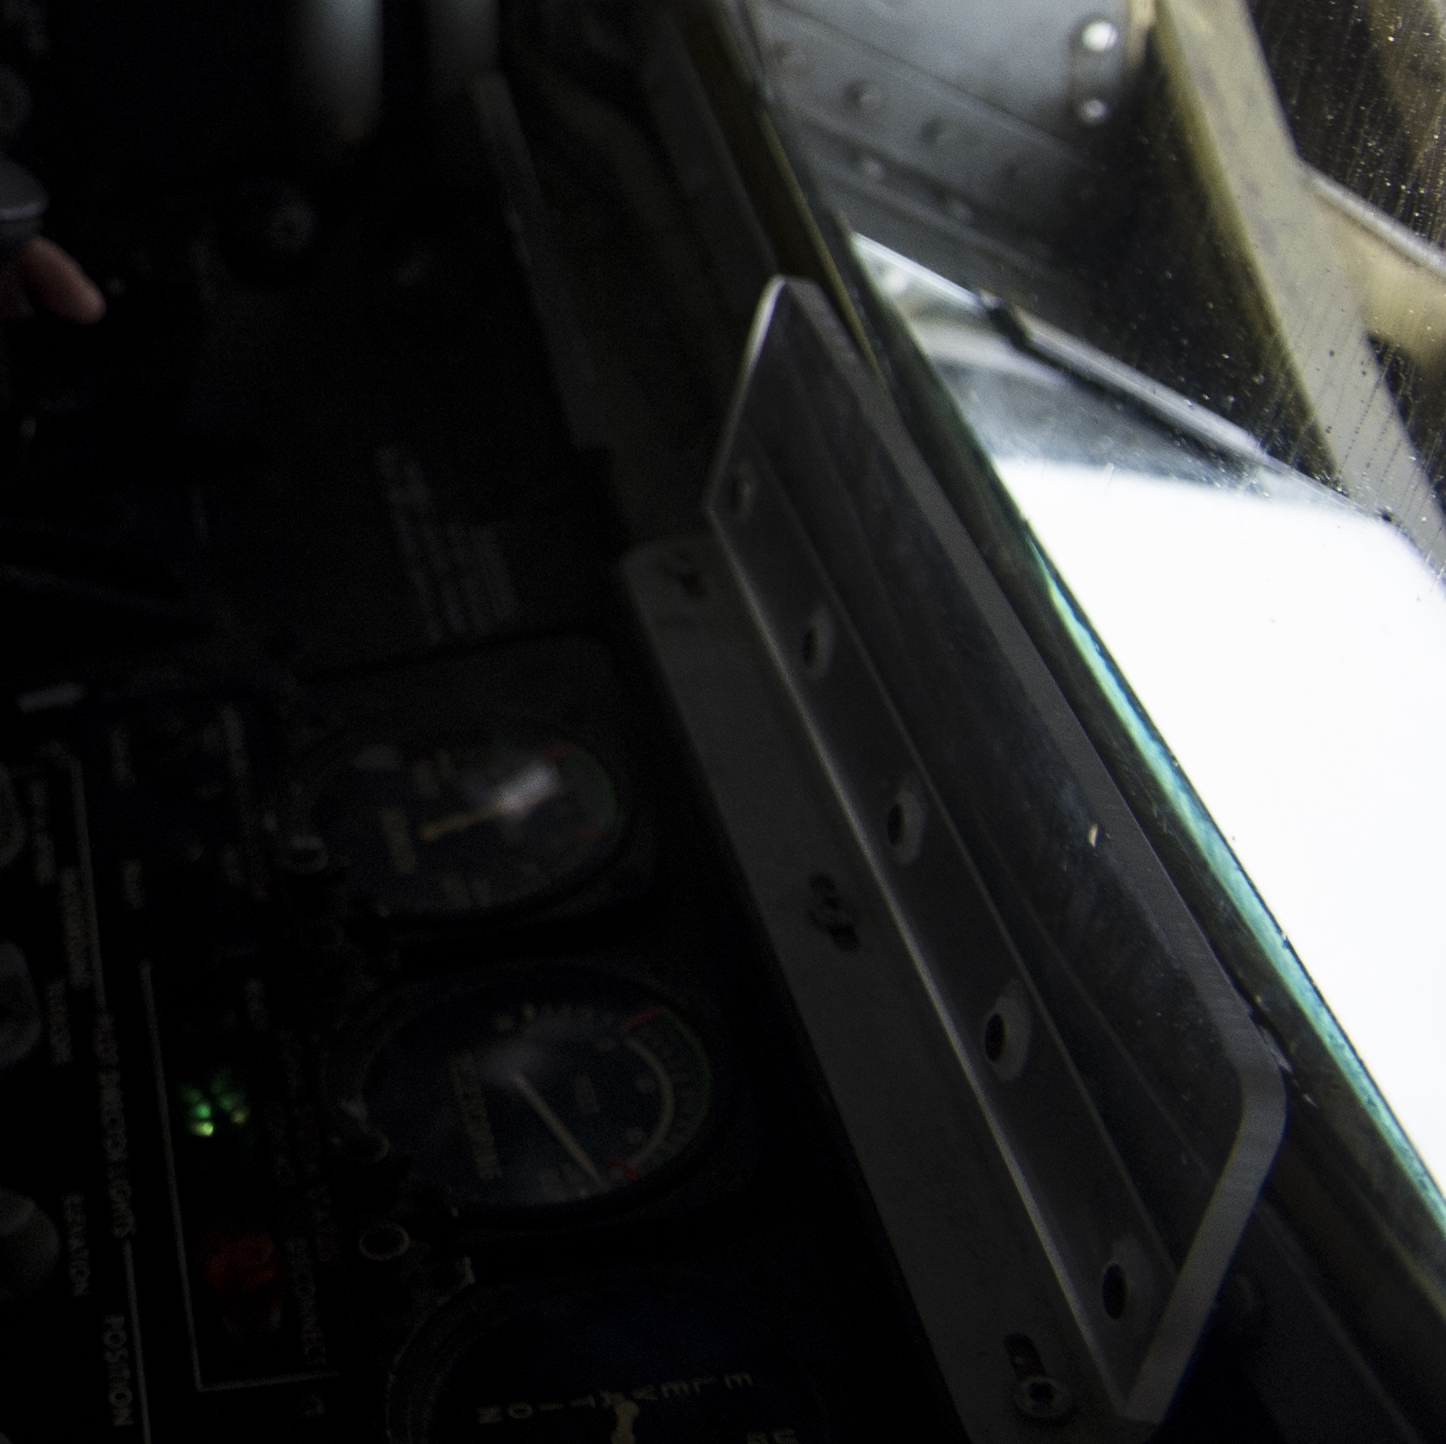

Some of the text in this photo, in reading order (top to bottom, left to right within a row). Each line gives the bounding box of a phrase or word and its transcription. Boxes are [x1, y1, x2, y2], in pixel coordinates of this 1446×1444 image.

[62, 1190, 93, 1298] ELEVATION
[285, 1235, 329, 1367] DISCONNECT
[101, 1313, 136, 1428] POSITION
[475, 1370, 754, 1426] ELEVATION
